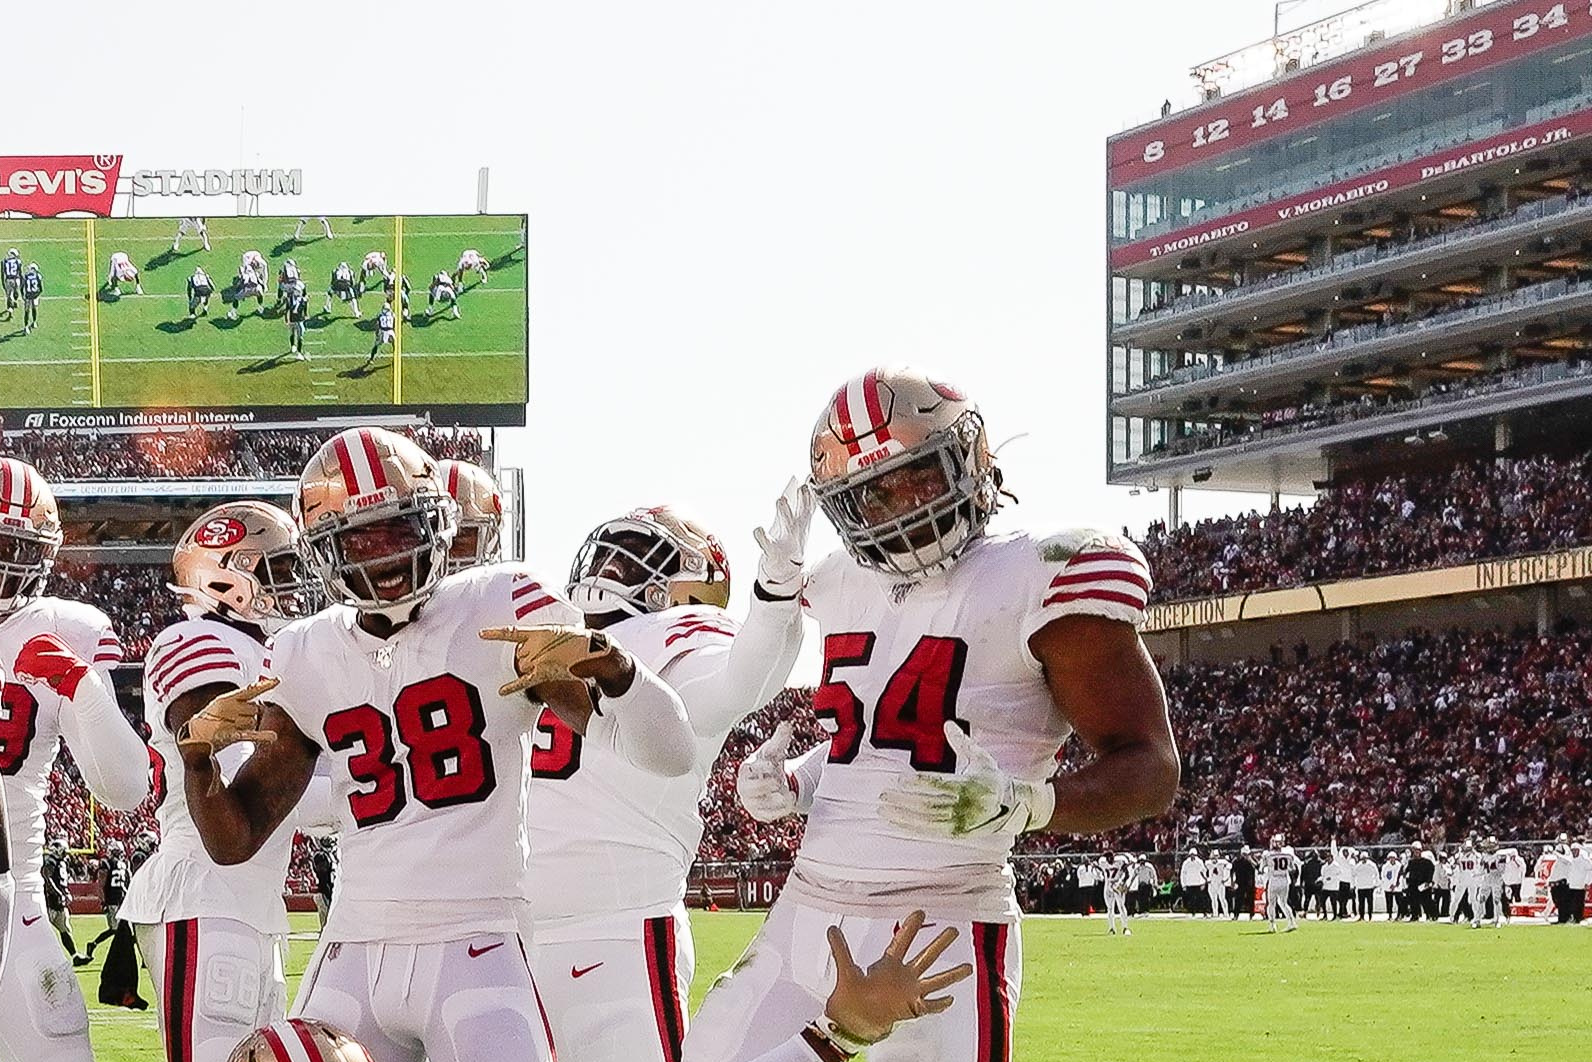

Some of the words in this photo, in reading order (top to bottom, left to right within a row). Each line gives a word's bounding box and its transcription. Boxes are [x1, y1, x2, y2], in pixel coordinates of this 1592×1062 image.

[1143, 140, 1165, 162] 8
[1192, 119, 1230, 148] 12
[1251, 99, 1289, 128] 14
[1313, 75, 1353, 107] 16
[1374, 51, 1423, 88] 27
[1441, 29, 1494, 65] 33
[1513, 3, 1568, 41] 34
[132, 167, 303, 197] STADIUM
[1294, 179, 1389, 215] MORABITO
[1163, 221, 1249, 254] MORABITO
[49, 413, 115, 427] Foxconn
[119, 411, 192, 426] Industrial
[195, 411, 255, 423] Internet
[812, 631, 970, 773] 54
[323, 672, 496, 828] 38
[1273, 857, 1288, 871] 10
